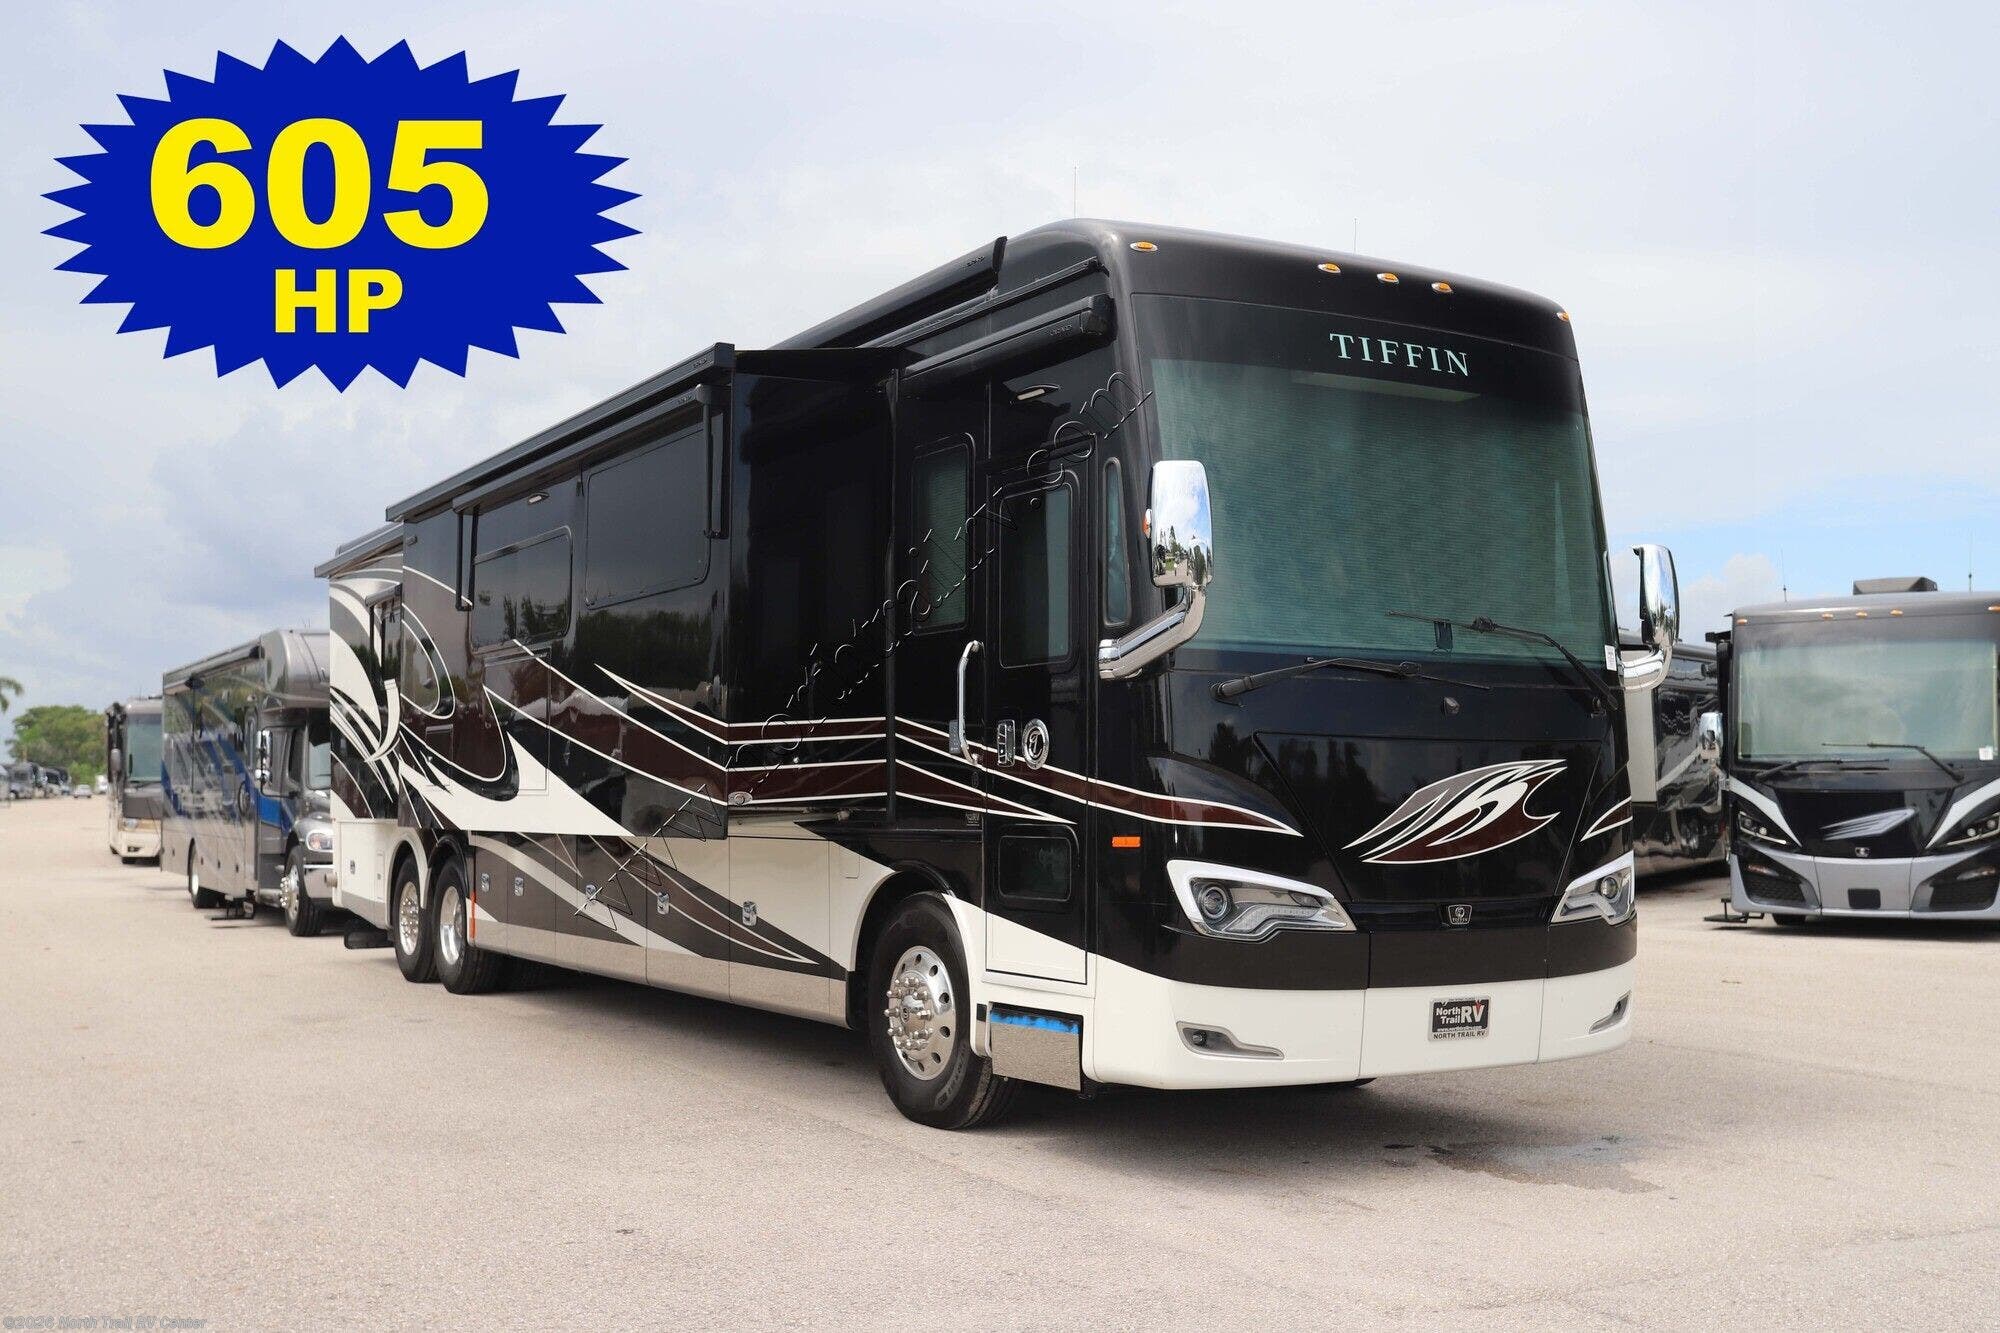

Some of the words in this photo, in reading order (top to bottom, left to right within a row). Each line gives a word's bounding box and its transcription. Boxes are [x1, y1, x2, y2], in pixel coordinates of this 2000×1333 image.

[1329, 333, 1469, 376] TIFFIN
[1436, 1007, 1461, 1016] North
[1461, 1005, 1485, 1023] RV
[1440, 1015, 1461, 1024] Trail
